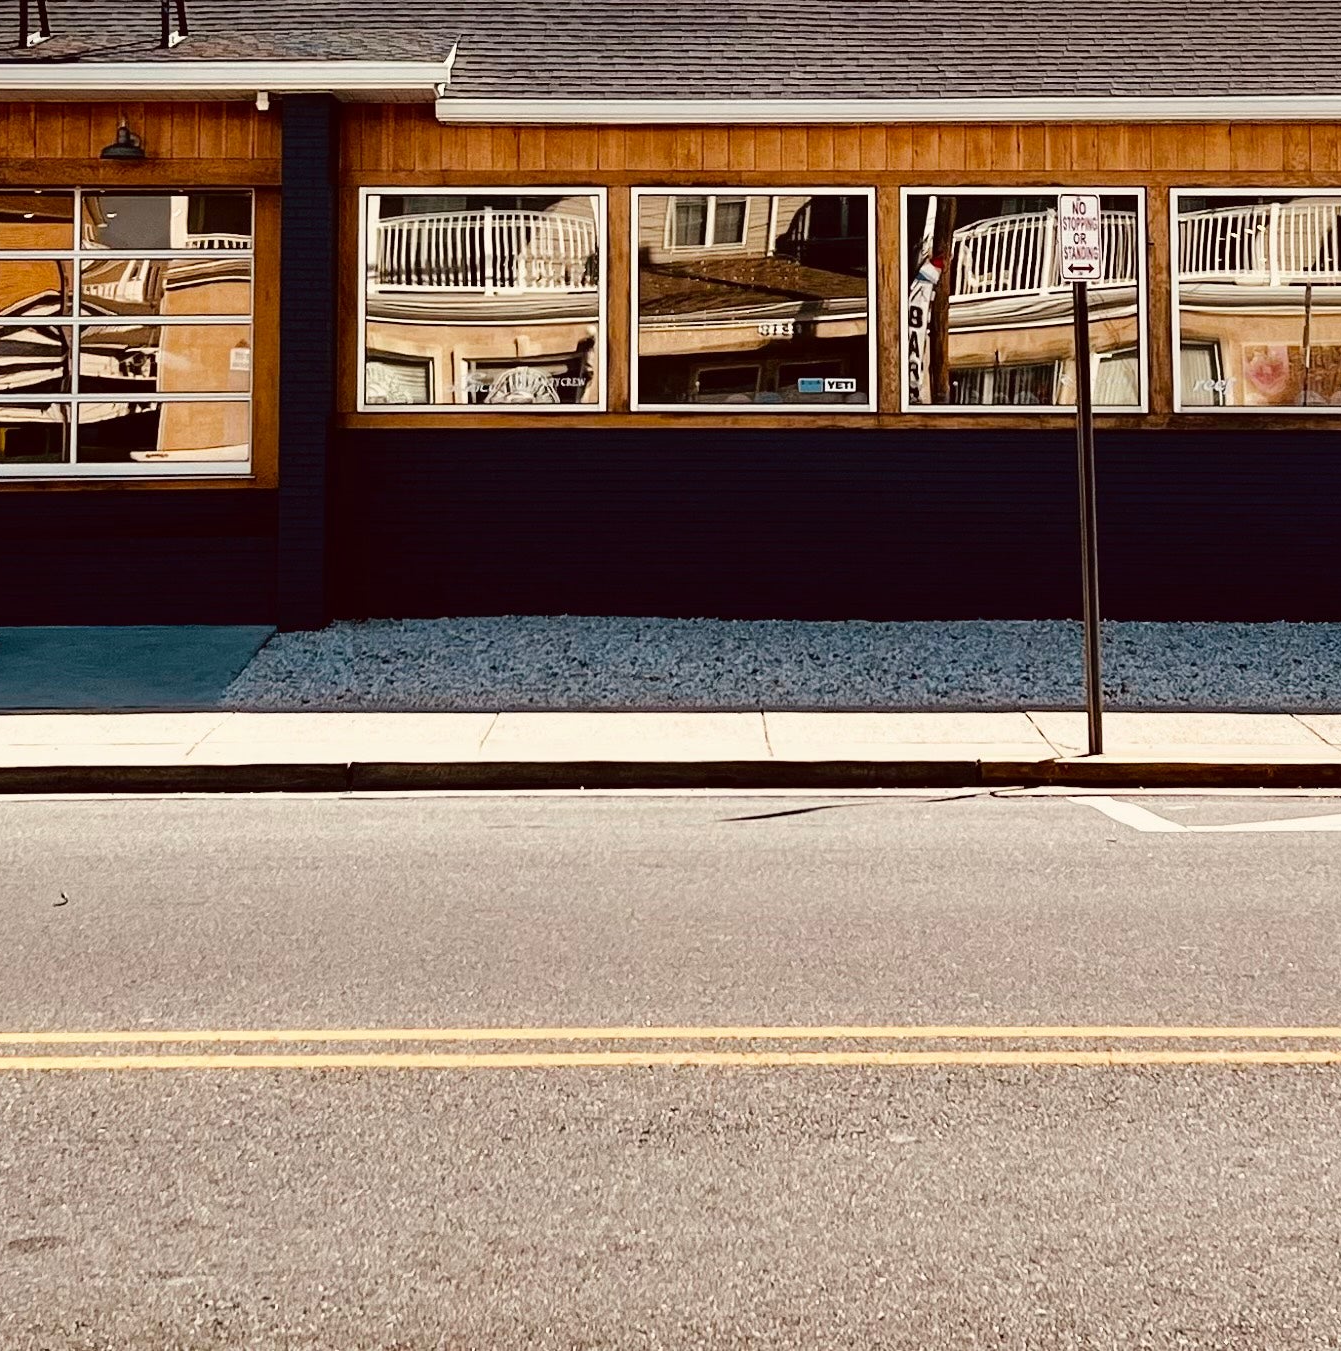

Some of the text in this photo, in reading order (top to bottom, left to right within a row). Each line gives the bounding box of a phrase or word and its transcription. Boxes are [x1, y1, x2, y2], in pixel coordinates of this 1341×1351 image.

[1072, 202, 1086, 214] NO
[1062, 216, 1098, 231] STOPPING
[1073, 233, 1087, 245] OR
[1063, 247, 1099, 260] STANDING
[827, 381, 854, 390] YETI
